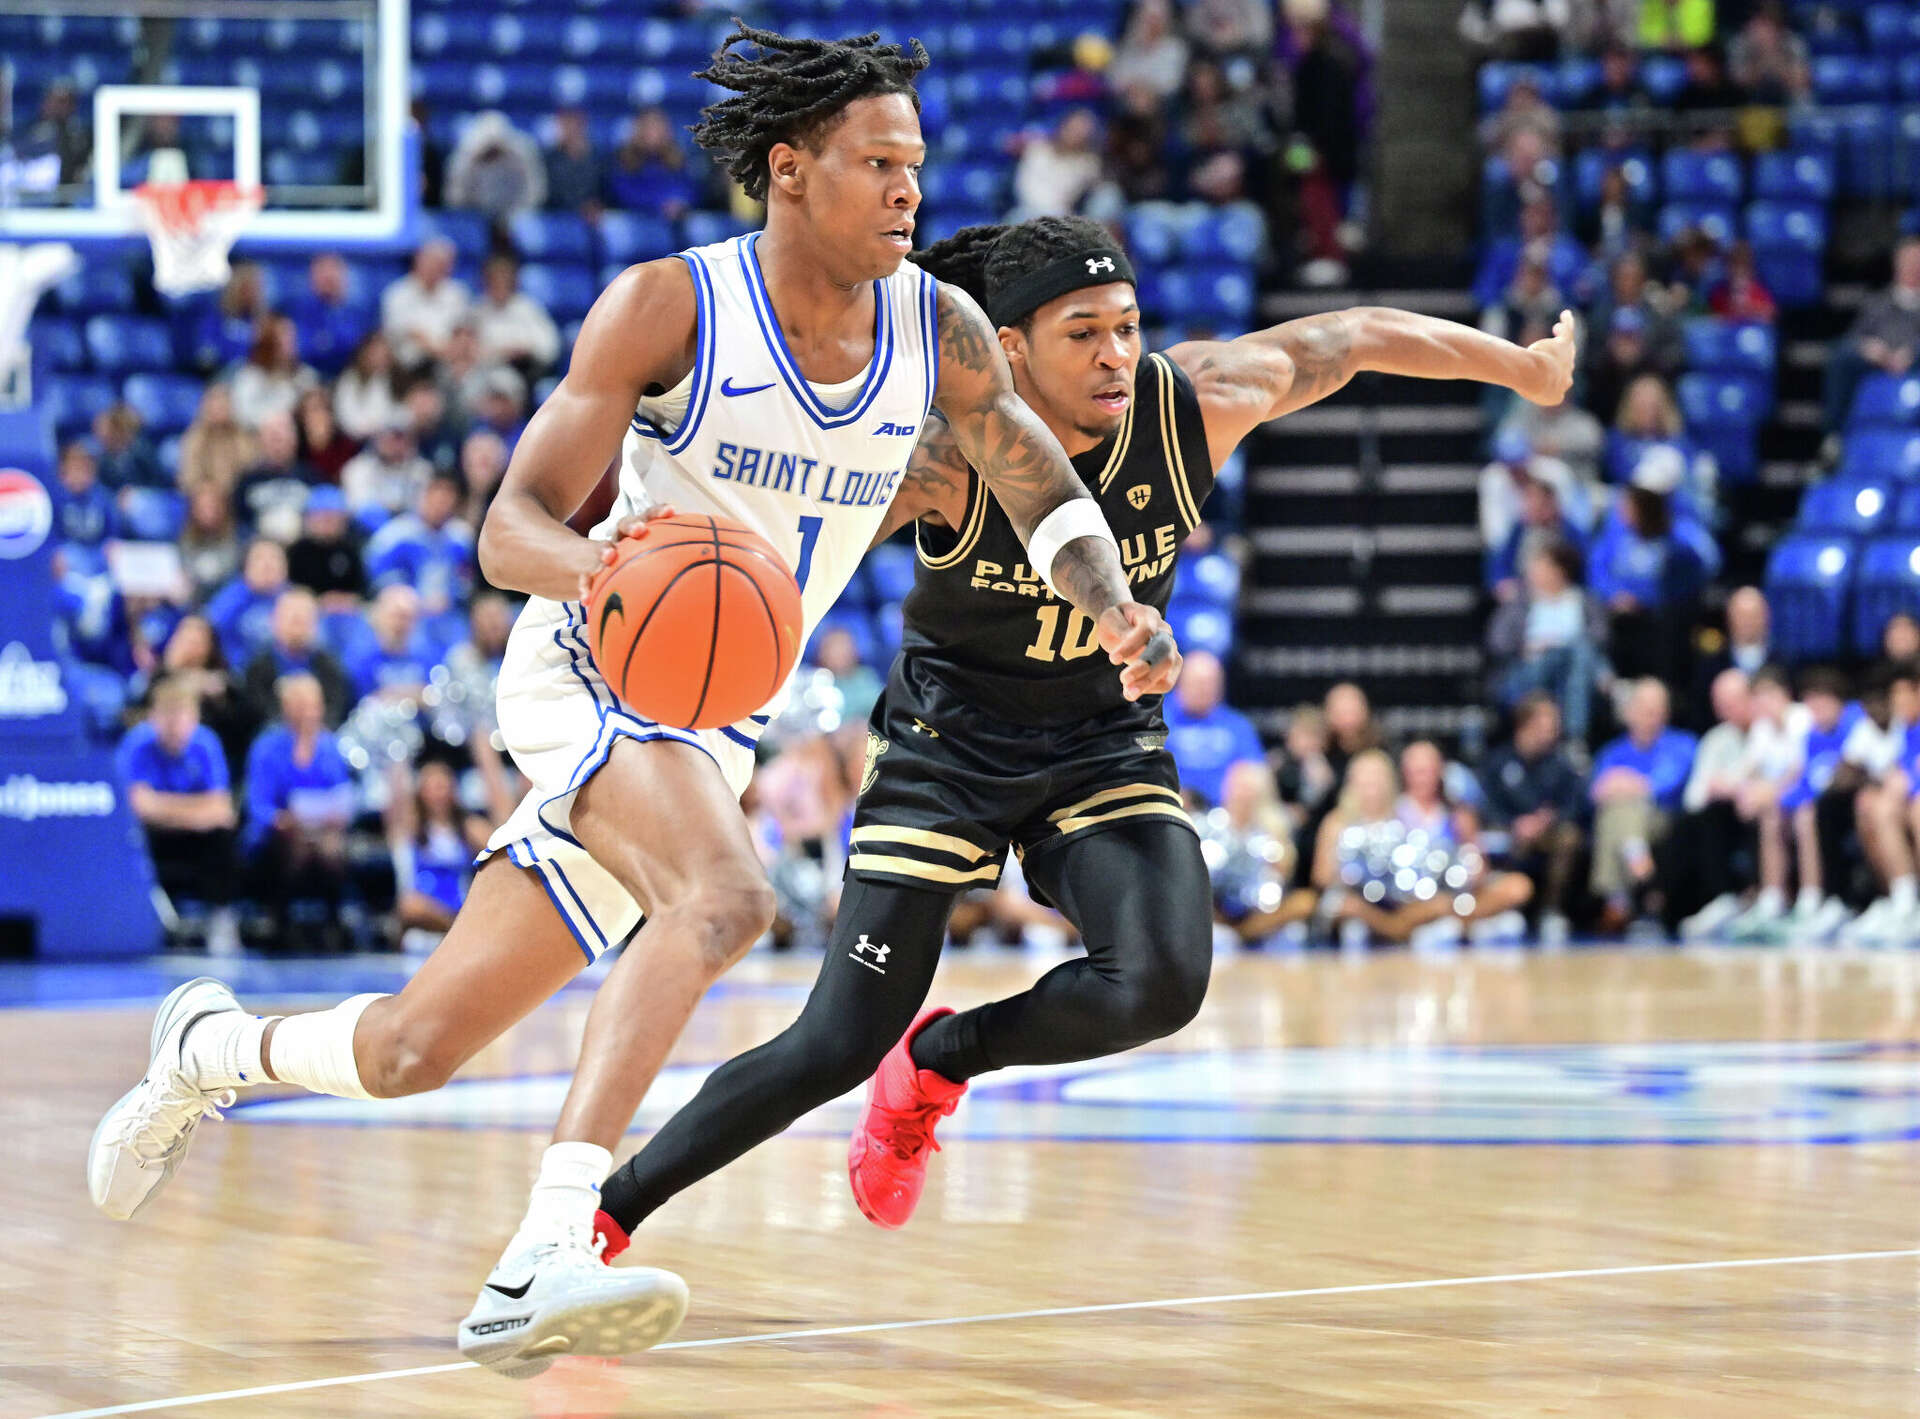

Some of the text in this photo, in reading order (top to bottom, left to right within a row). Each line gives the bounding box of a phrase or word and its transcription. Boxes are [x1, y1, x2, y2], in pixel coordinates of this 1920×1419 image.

[872, 422, 915, 436] A10
[713, 440, 900, 506] SAINT LOUIS
[795, 515, 824, 596] 1
[976, 524, 1176, 582] PUUE
[970, 576, 1055, 602] FORT
[1024, 605, 1100, 662] 10
